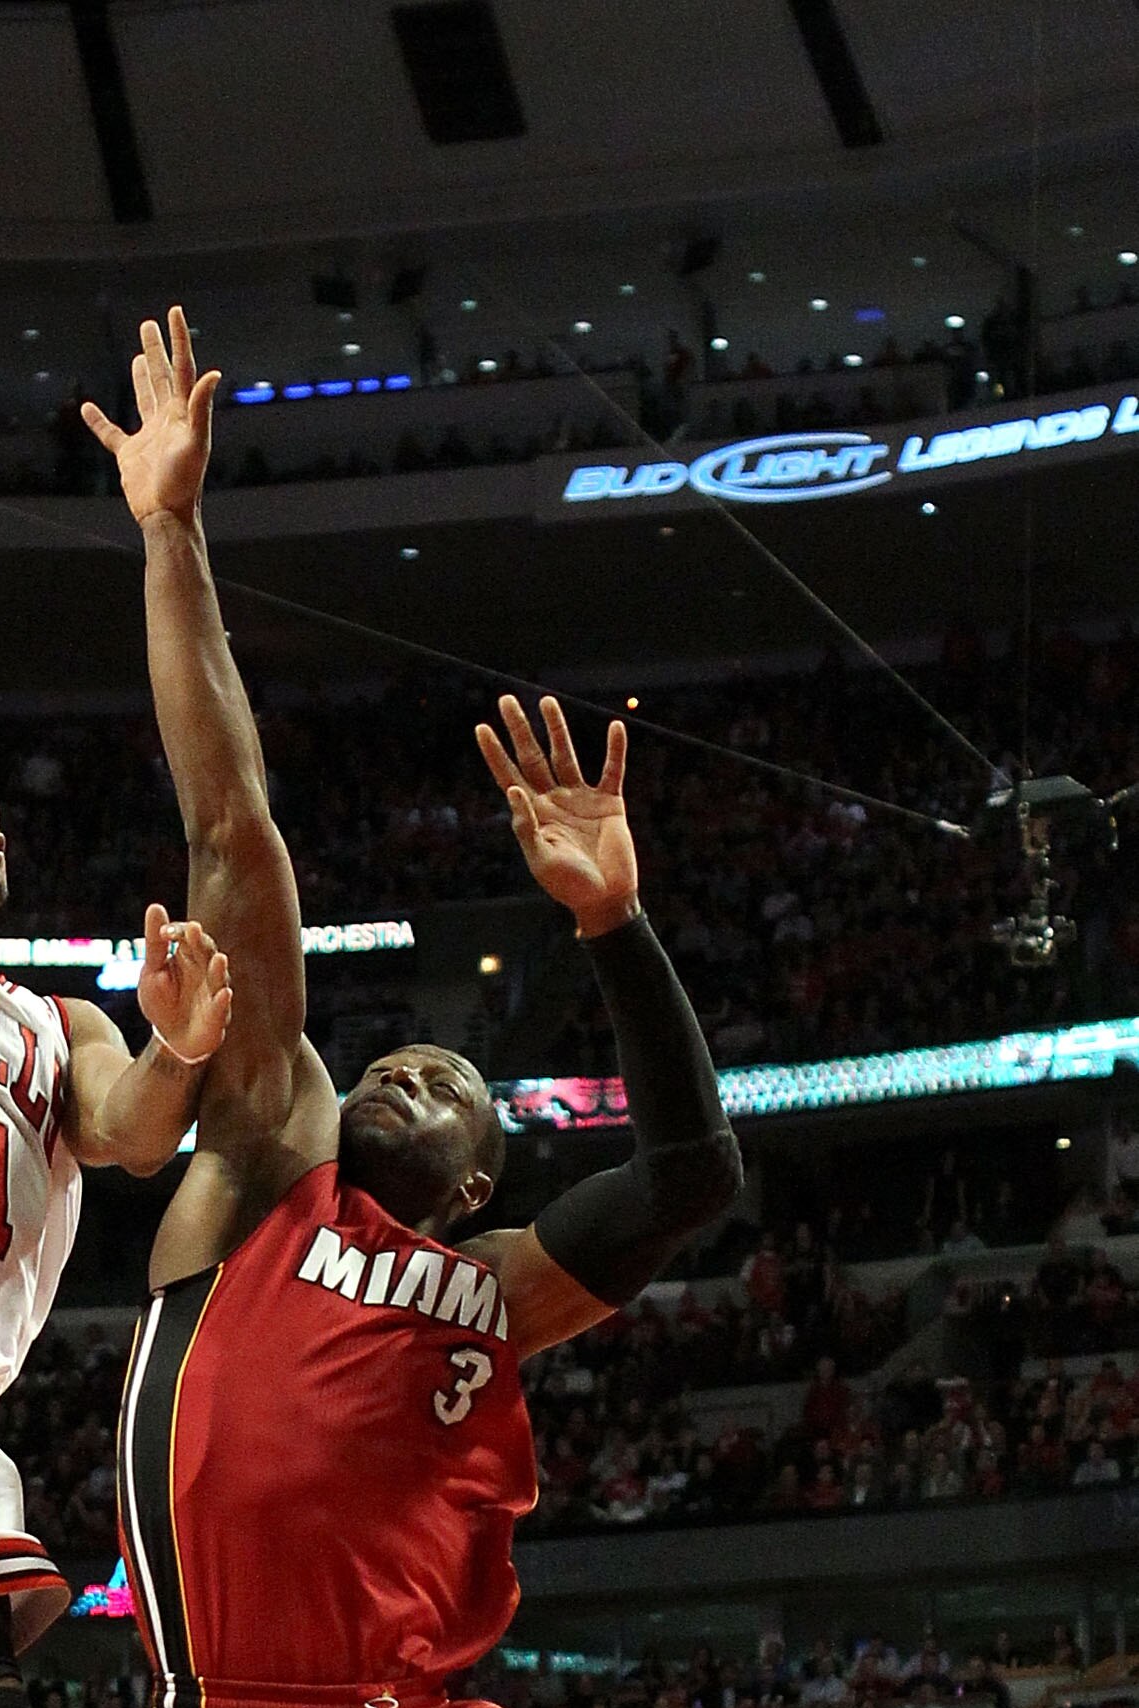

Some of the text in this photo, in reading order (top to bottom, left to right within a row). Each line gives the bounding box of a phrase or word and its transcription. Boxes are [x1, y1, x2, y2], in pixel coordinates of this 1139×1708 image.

[564, 461, 689, 502] BUD
[721, 443, 890, 488] LIGHT
[897, 405, 1111, 473] LEGENDS
[300, 920, 415, 955] ORCHESTRA
[433, 1347, 494, 1426] 3
